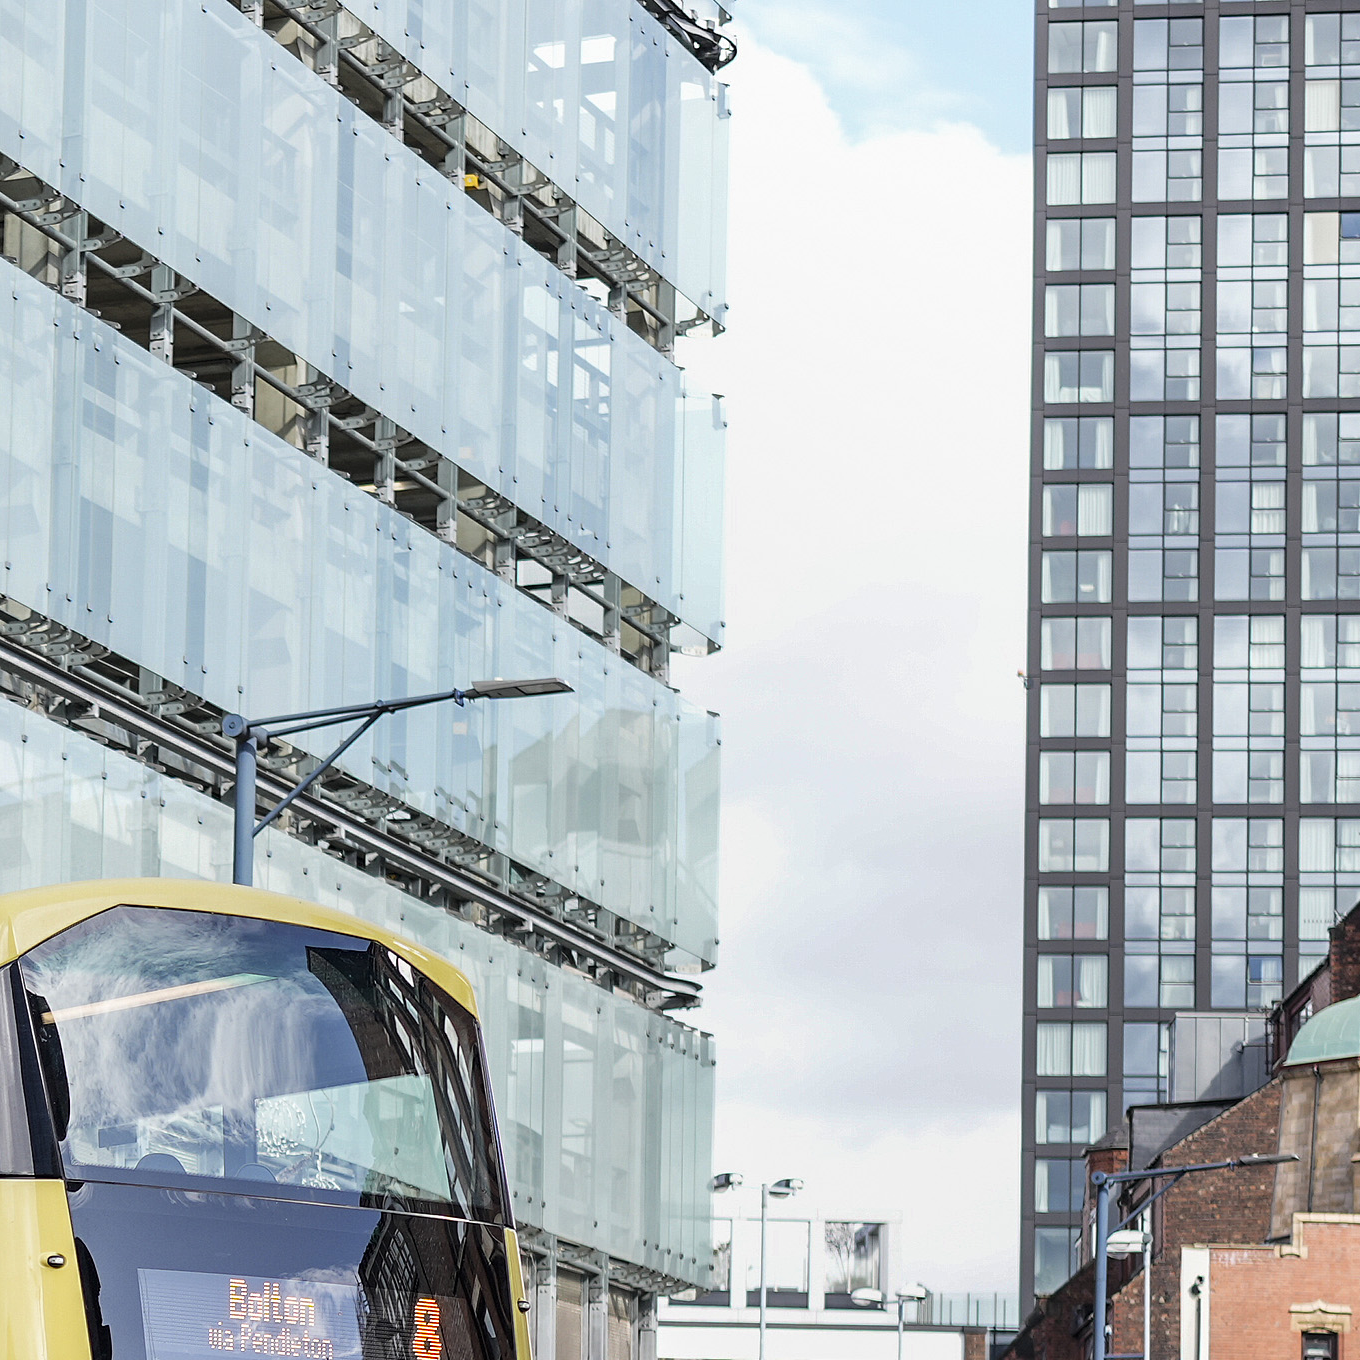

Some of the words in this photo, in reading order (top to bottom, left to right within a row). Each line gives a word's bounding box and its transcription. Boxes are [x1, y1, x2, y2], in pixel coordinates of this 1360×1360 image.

[229, 1278, 315, 1327] Bolton
[208, 1321, 234, 1351] via
[240, 1323, 334, 1360] Pendleton
